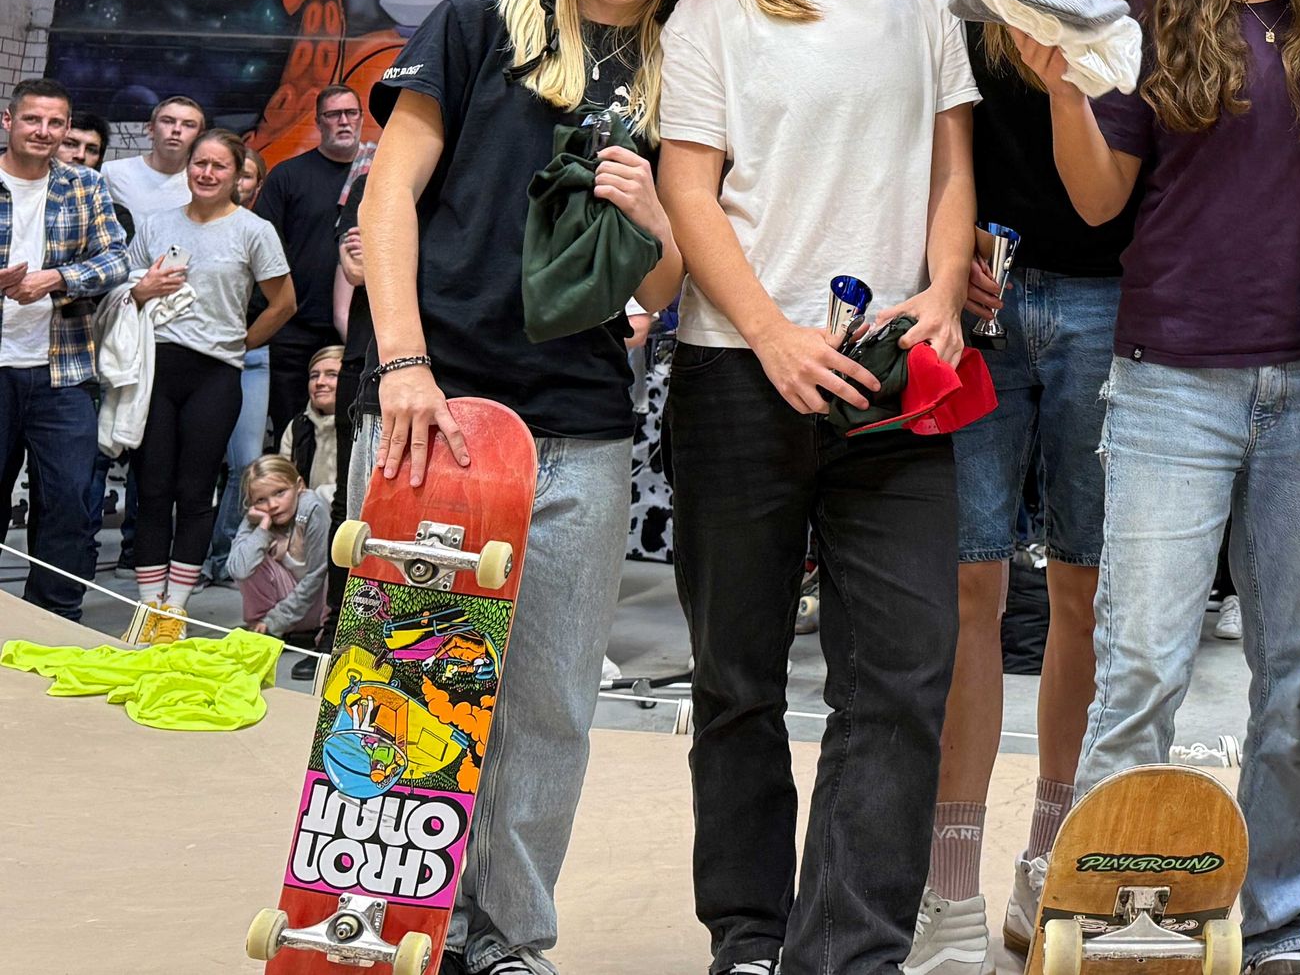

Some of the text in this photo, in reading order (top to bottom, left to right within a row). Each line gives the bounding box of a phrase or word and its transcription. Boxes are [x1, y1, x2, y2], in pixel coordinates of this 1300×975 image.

[933, 825, 981, 841] VANS
[292, 830, 448, 897] CHRON
[1080, 855, 1221, 873] PLAYGROUND
